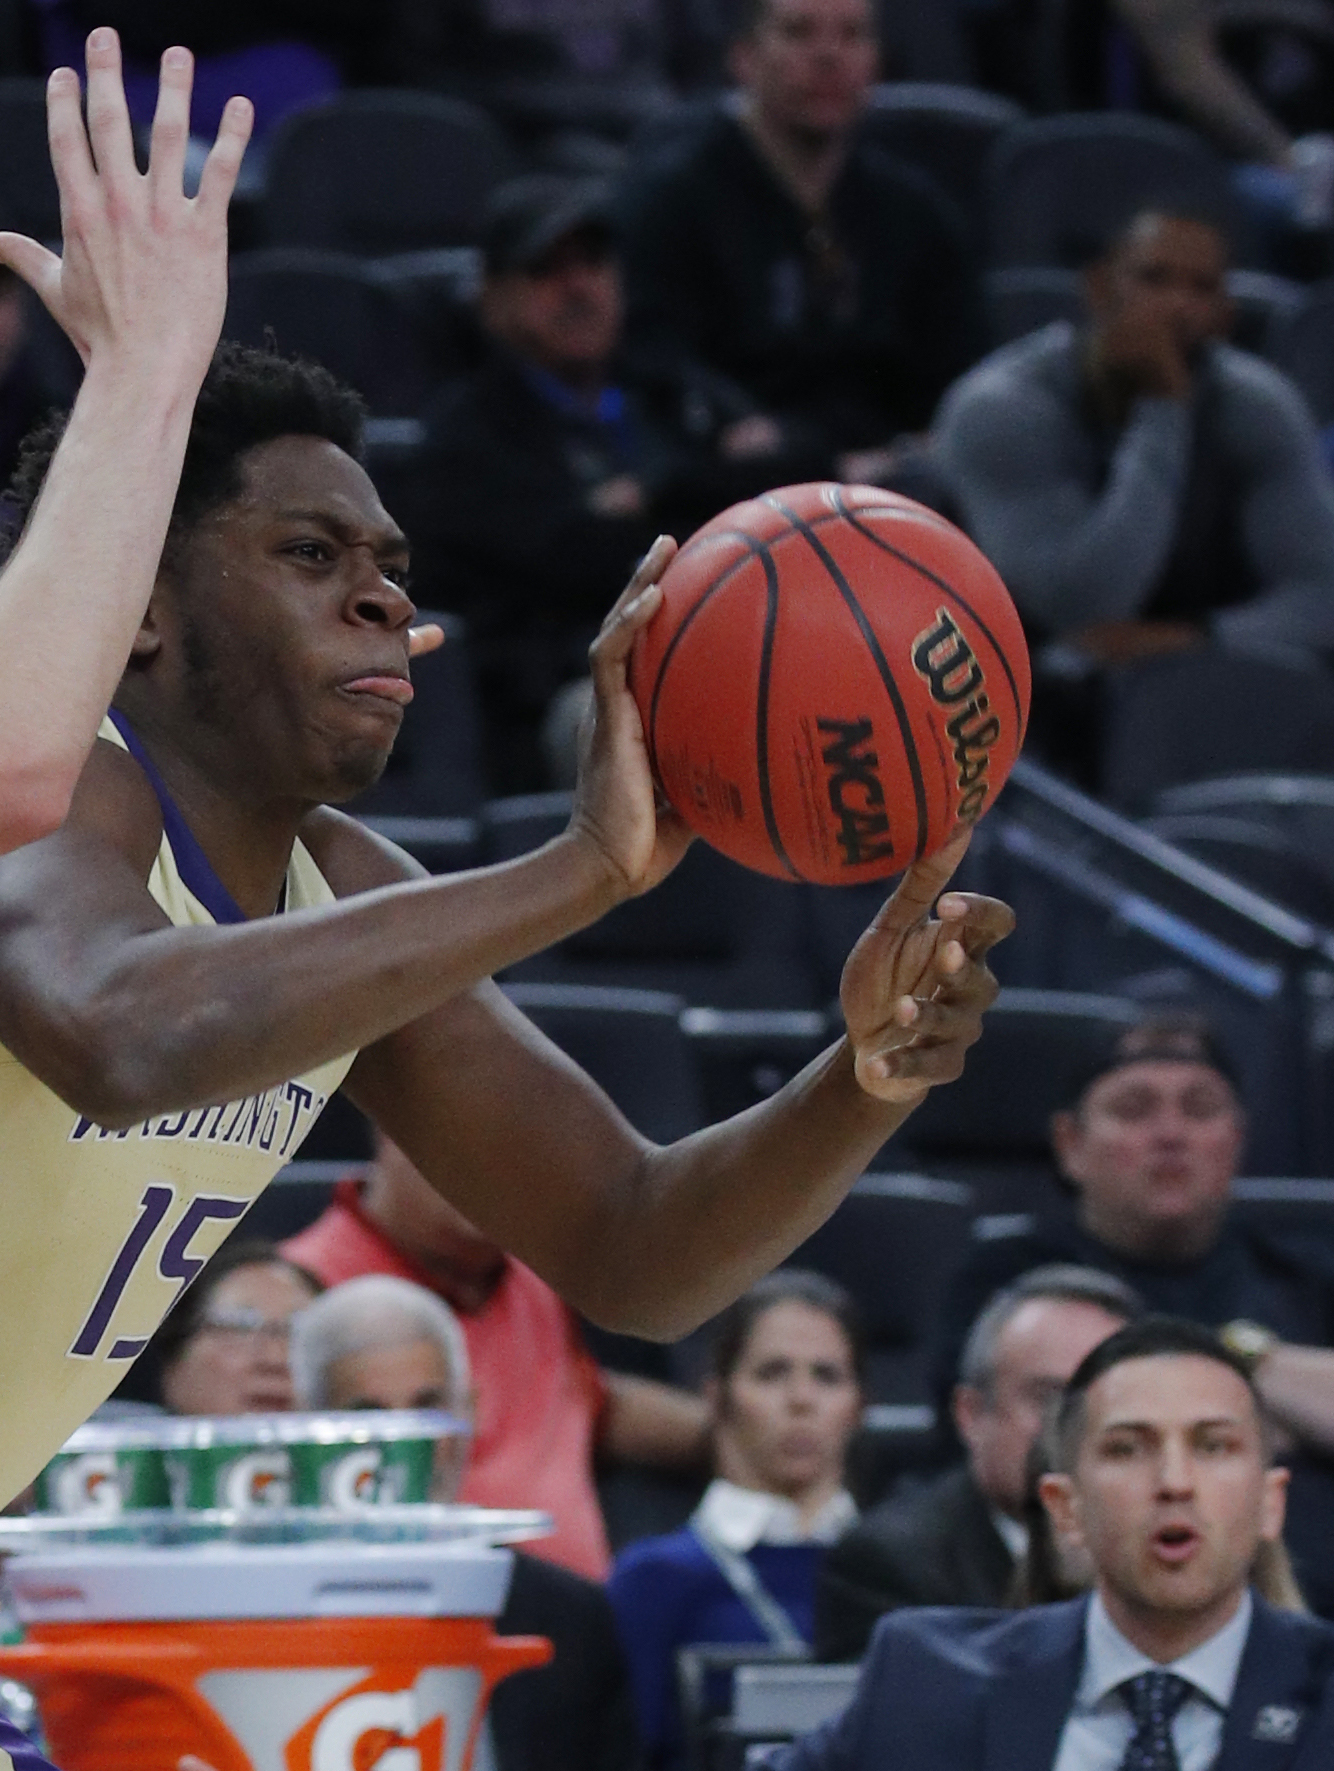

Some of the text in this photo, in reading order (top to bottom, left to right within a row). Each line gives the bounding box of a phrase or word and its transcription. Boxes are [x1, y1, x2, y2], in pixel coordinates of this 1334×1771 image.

[817, 715, 895, 866] NCAA
[910, 606, 1001, 824] Wilso
[68, 1183, 258, 1361] 15
